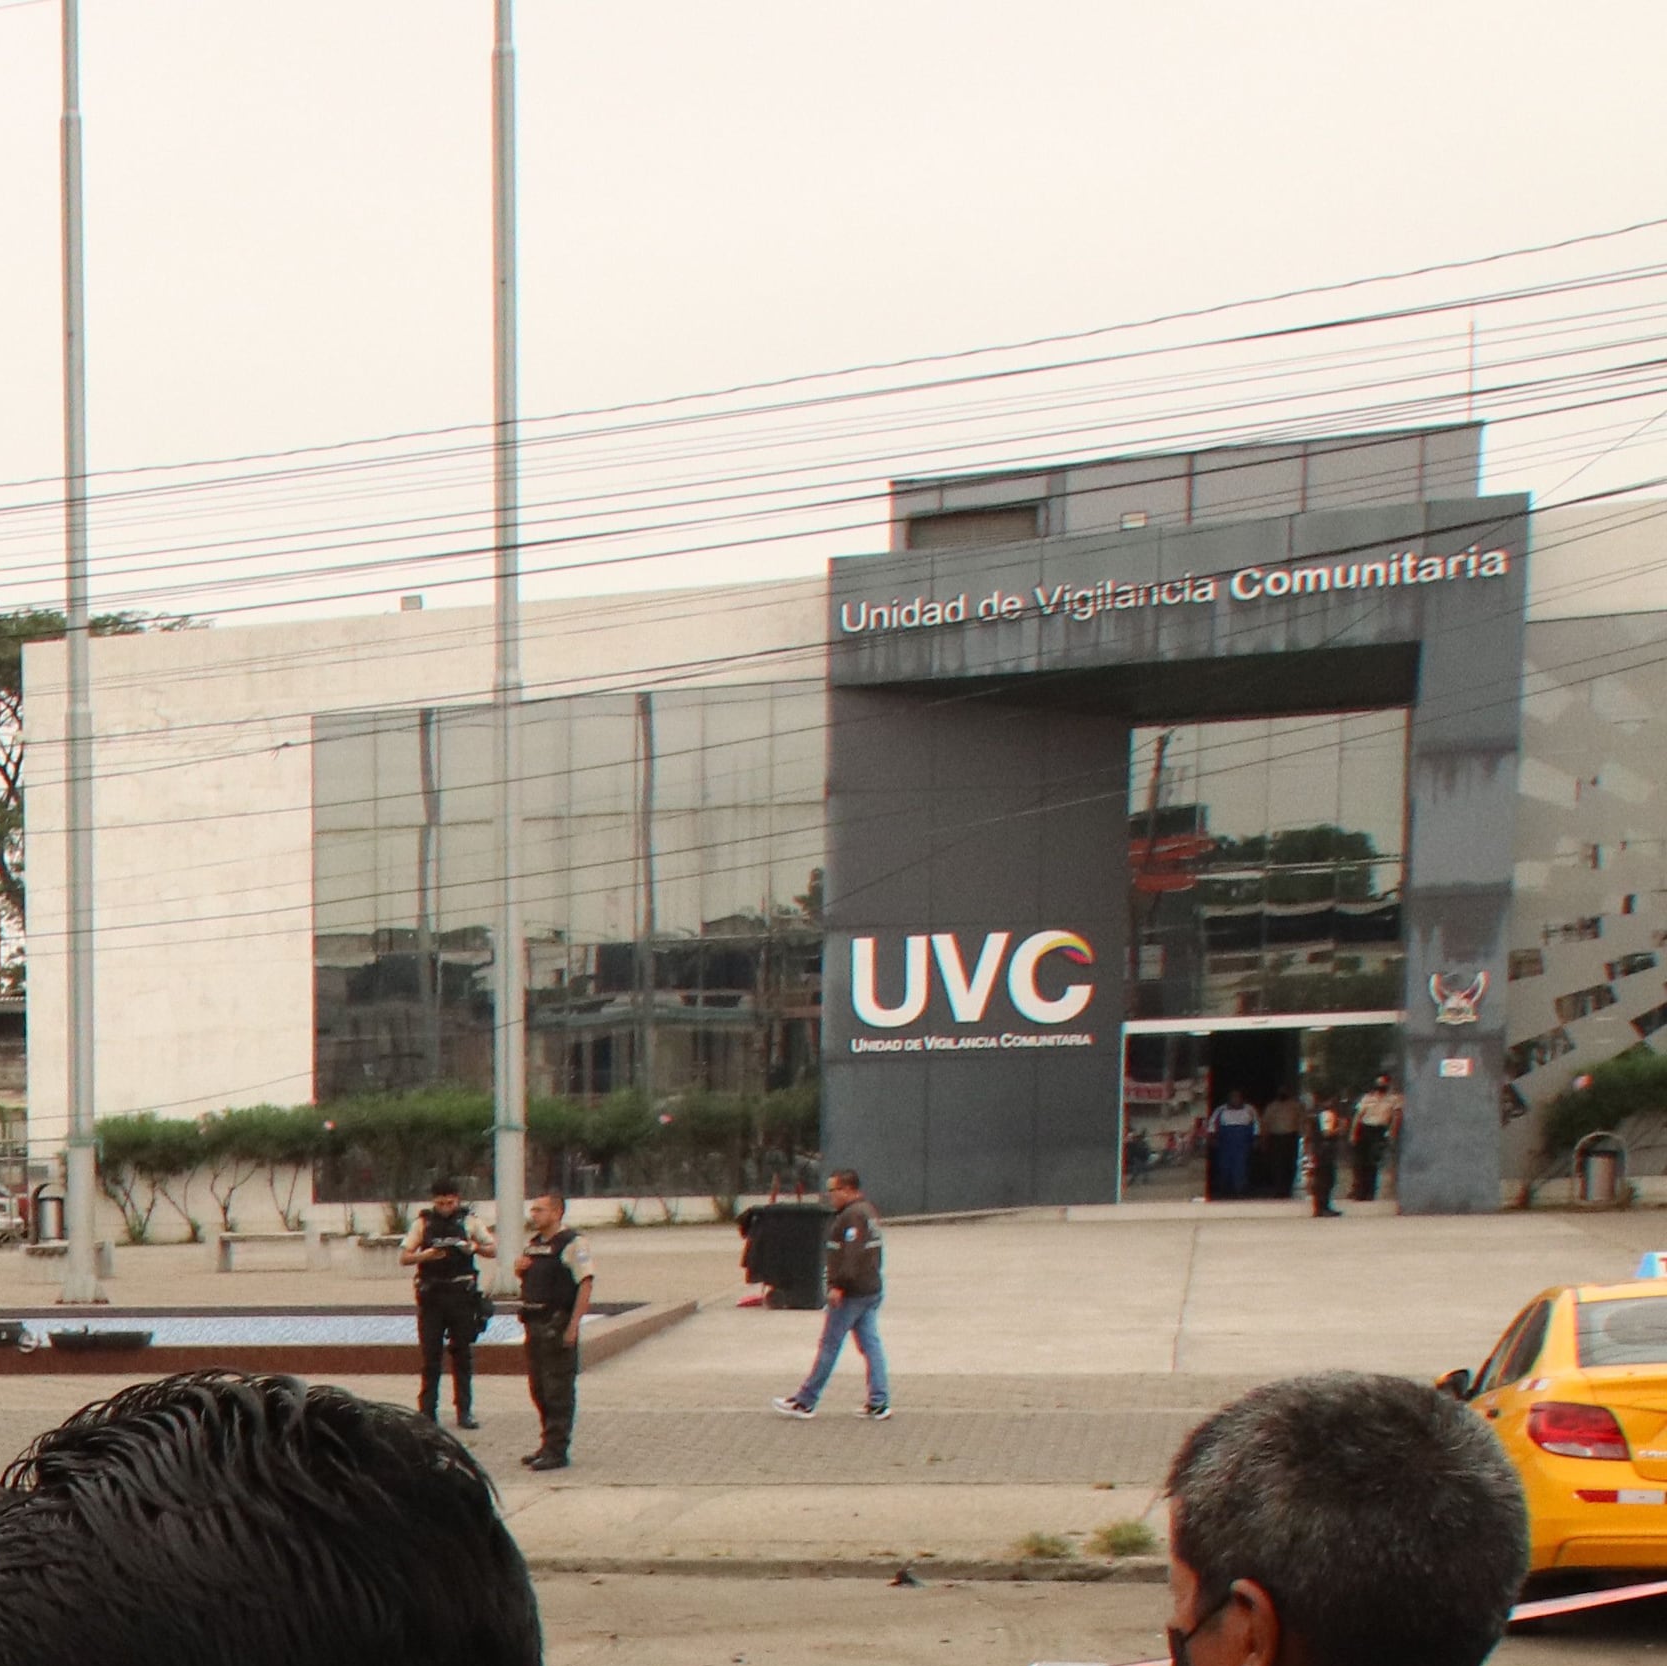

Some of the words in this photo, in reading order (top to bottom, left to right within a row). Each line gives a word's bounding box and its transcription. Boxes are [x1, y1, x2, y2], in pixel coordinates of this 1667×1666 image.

[840, 593, 967, 633] Unidad
[977, 589, 1024, 622] de
[1034, 572, 1220, 622] Vigilancia
[1230, 545, 1511, 601] Comunitaria
[851, 930, 1094, 1028] UVC
[851, 1037, 902, 1053] UNIDAD
[904, 1037, 922, 1052] DE
[923, 1035, 998, 1051] VIGILANCIA
[999, 1032, 1093, 1049] COMUNITARIA
